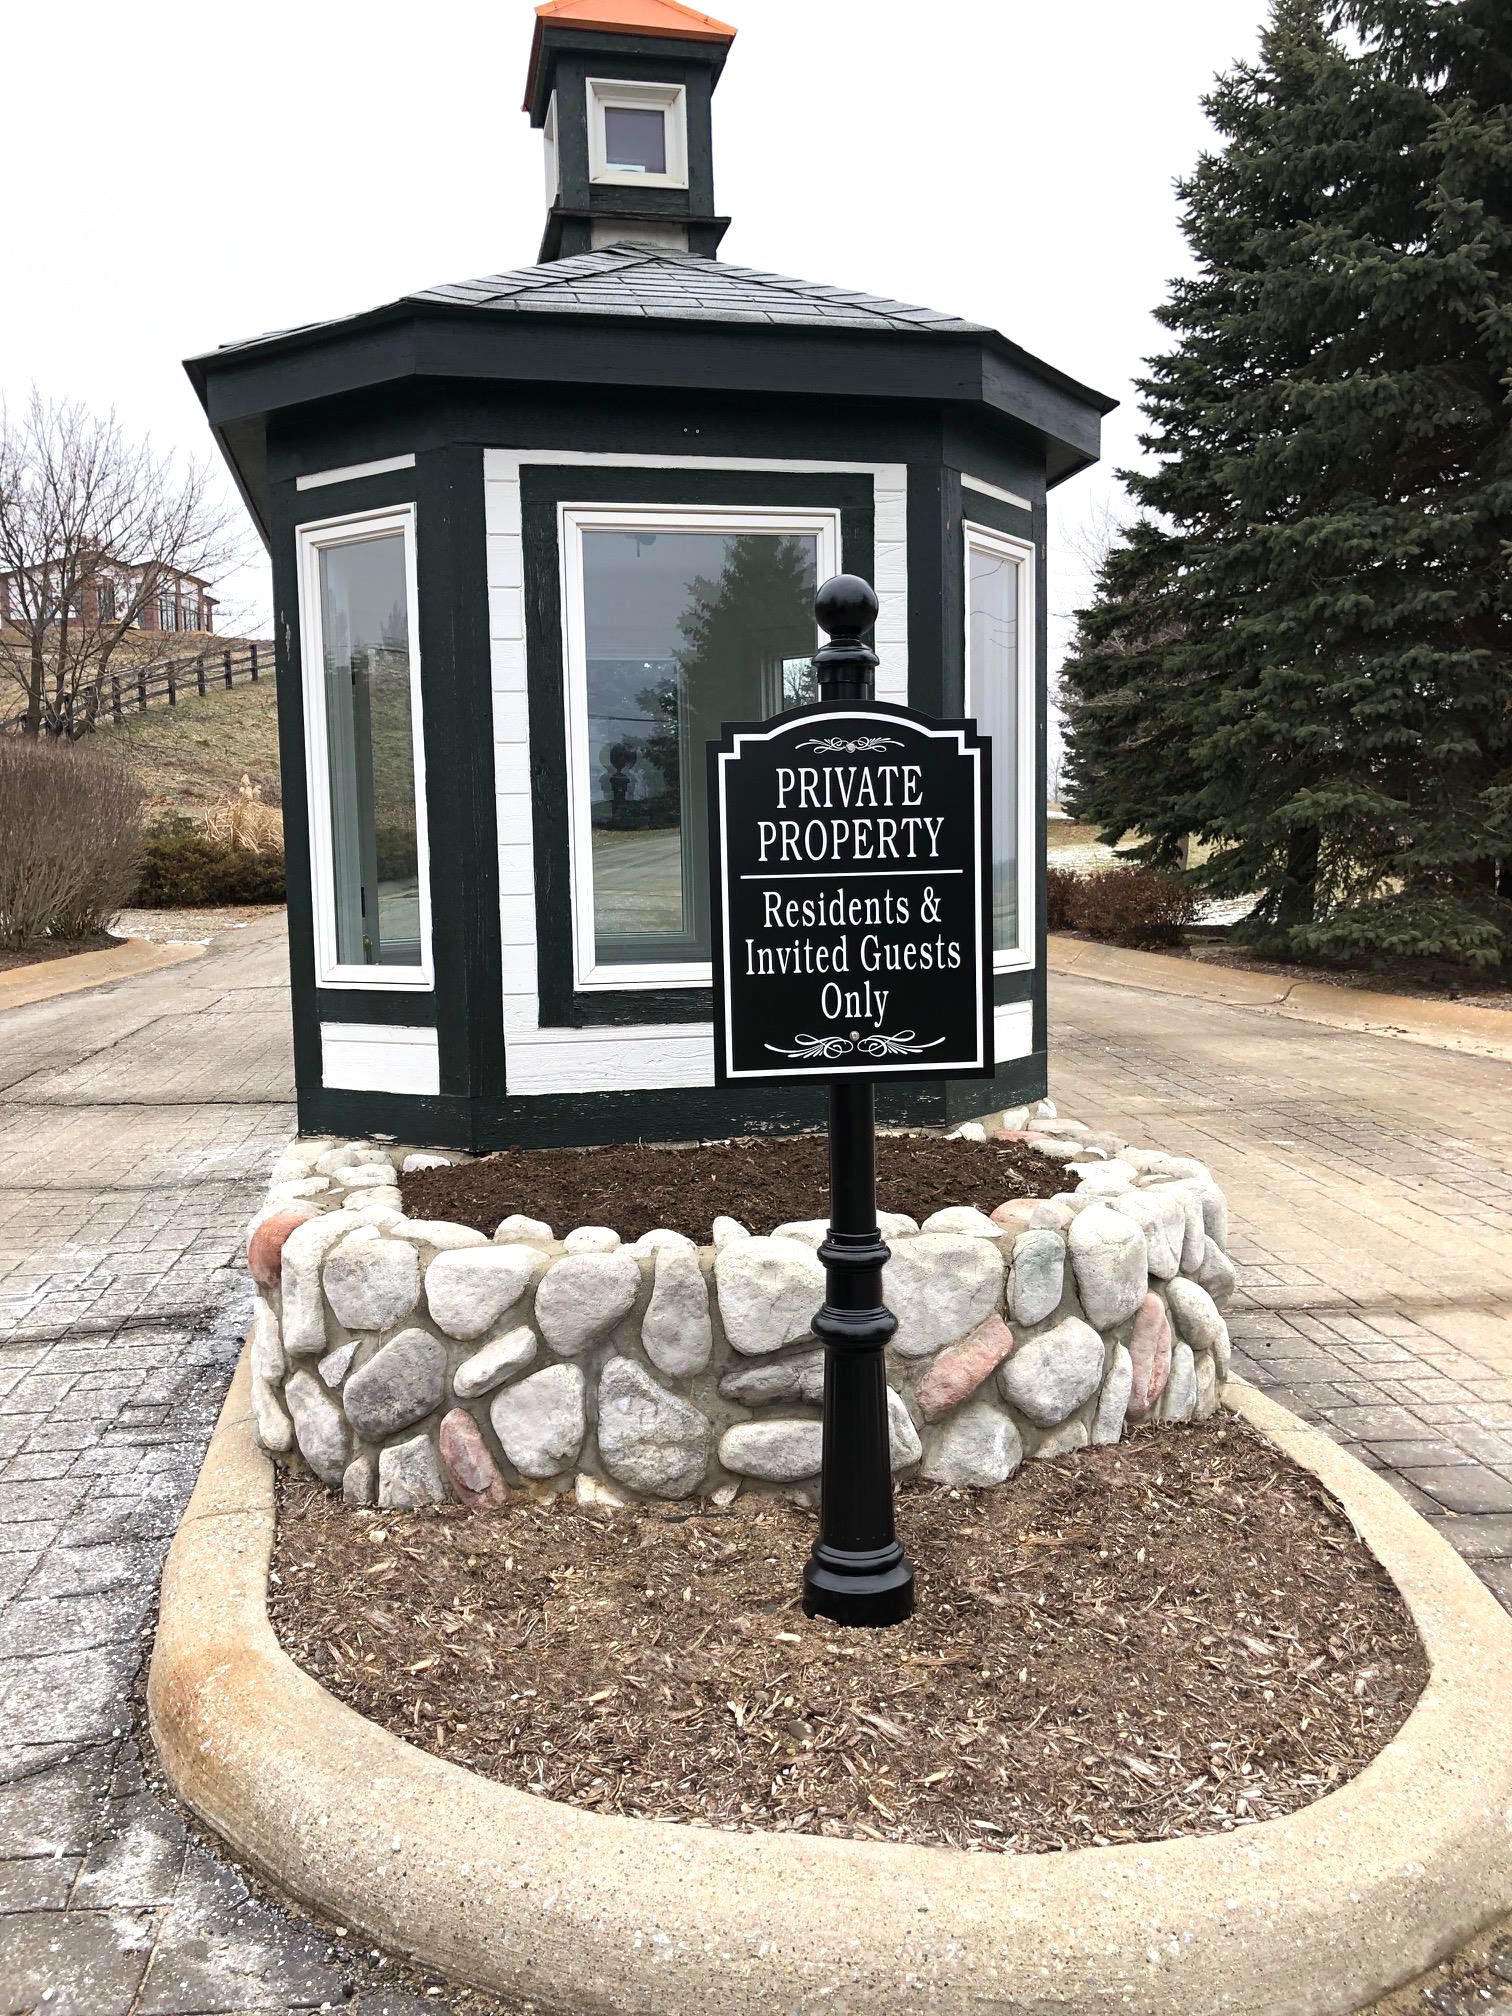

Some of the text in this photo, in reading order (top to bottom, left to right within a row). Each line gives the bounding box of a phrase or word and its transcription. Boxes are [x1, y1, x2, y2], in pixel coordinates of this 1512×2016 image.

[776, 765, 923, 809] PRIVATE
[757, 817, 945, 862] PROPERTY
[762, 886, 942, 928] Residents &
[745, 933, 961, 975] Invited Guests
[821, 980, 889, 1026] Only
